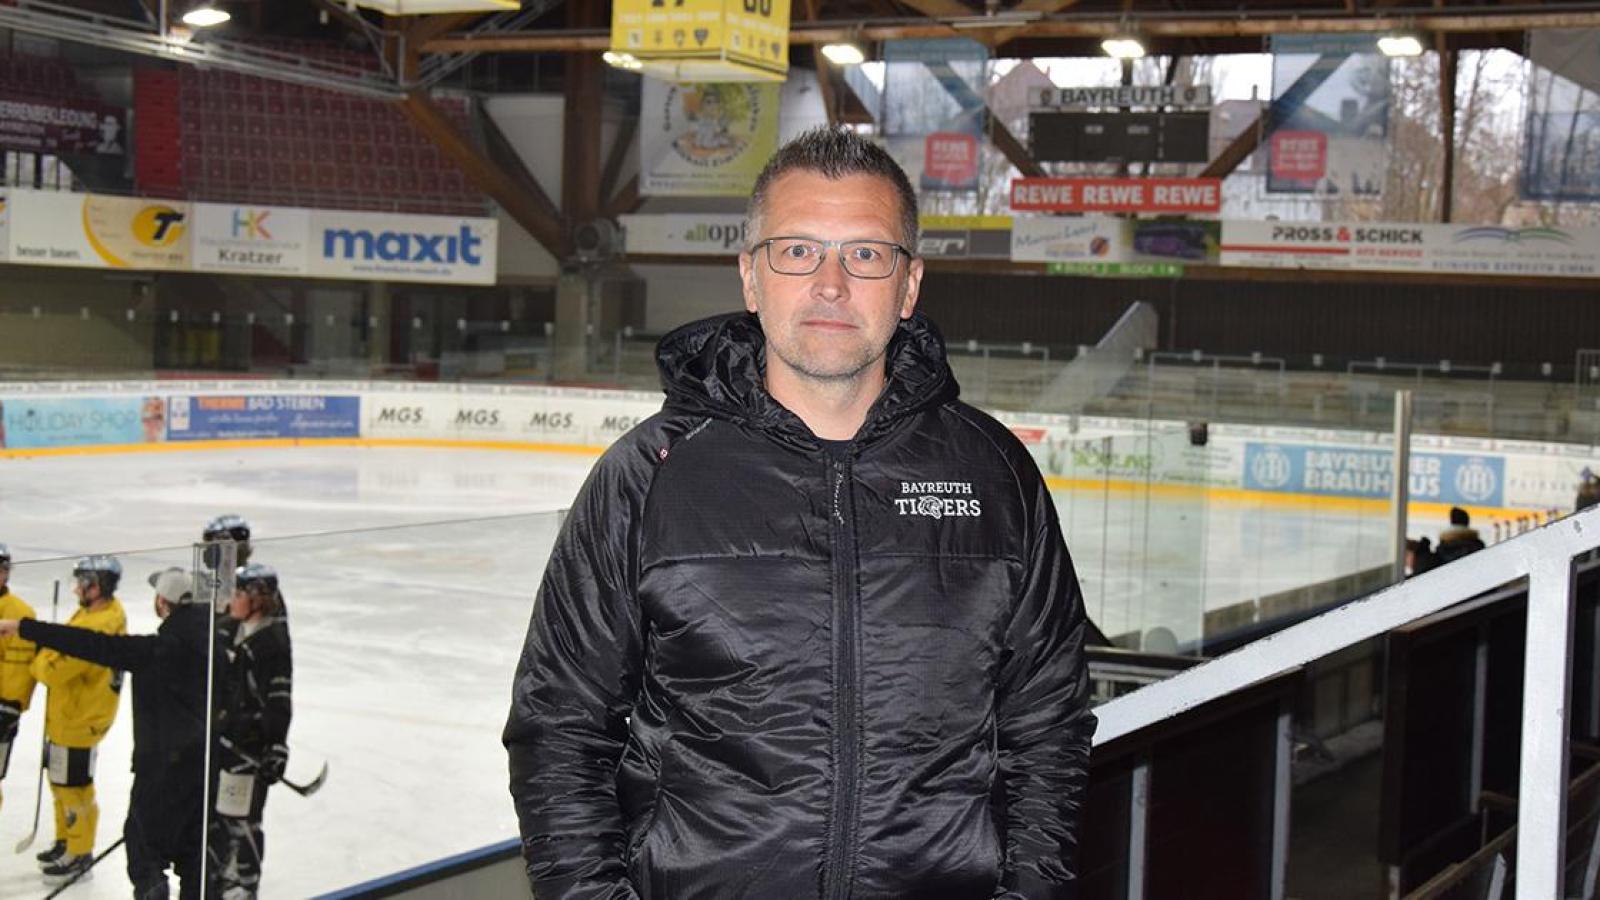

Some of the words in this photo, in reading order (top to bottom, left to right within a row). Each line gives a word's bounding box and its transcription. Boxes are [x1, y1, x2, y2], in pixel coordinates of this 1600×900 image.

[1062, 88, 1175, 105] BAYREUTH
[1014, 185, 1073, 204] REWE
[1083, 186, 1143, 204] REWE
[1154, 186, 1216, 205] REWE
[1273, 227, 1333, 241] PROSS
[1336, 227, 1351, 242] &
[1356, 229, 1424, 244] SCHICK
[324, 225, 481, 266] maxit
[218, 249, 284, 264] Kratzer
[250, 397, 275, 410] BAD
[278, 397, 325, 411] STEBEN
[89, 411, 137, 431] SHOP
[378, 407, 423, 424] MGS
[456, 409, 500, 426] MGS
[530, 413, 573, 429] MGS
[1305, 450, 1441, 475] BAYREUTER
[901, 482, 973, 494] BAYREUTH
[1304, 468, 1440, 497] BRAUHUS
